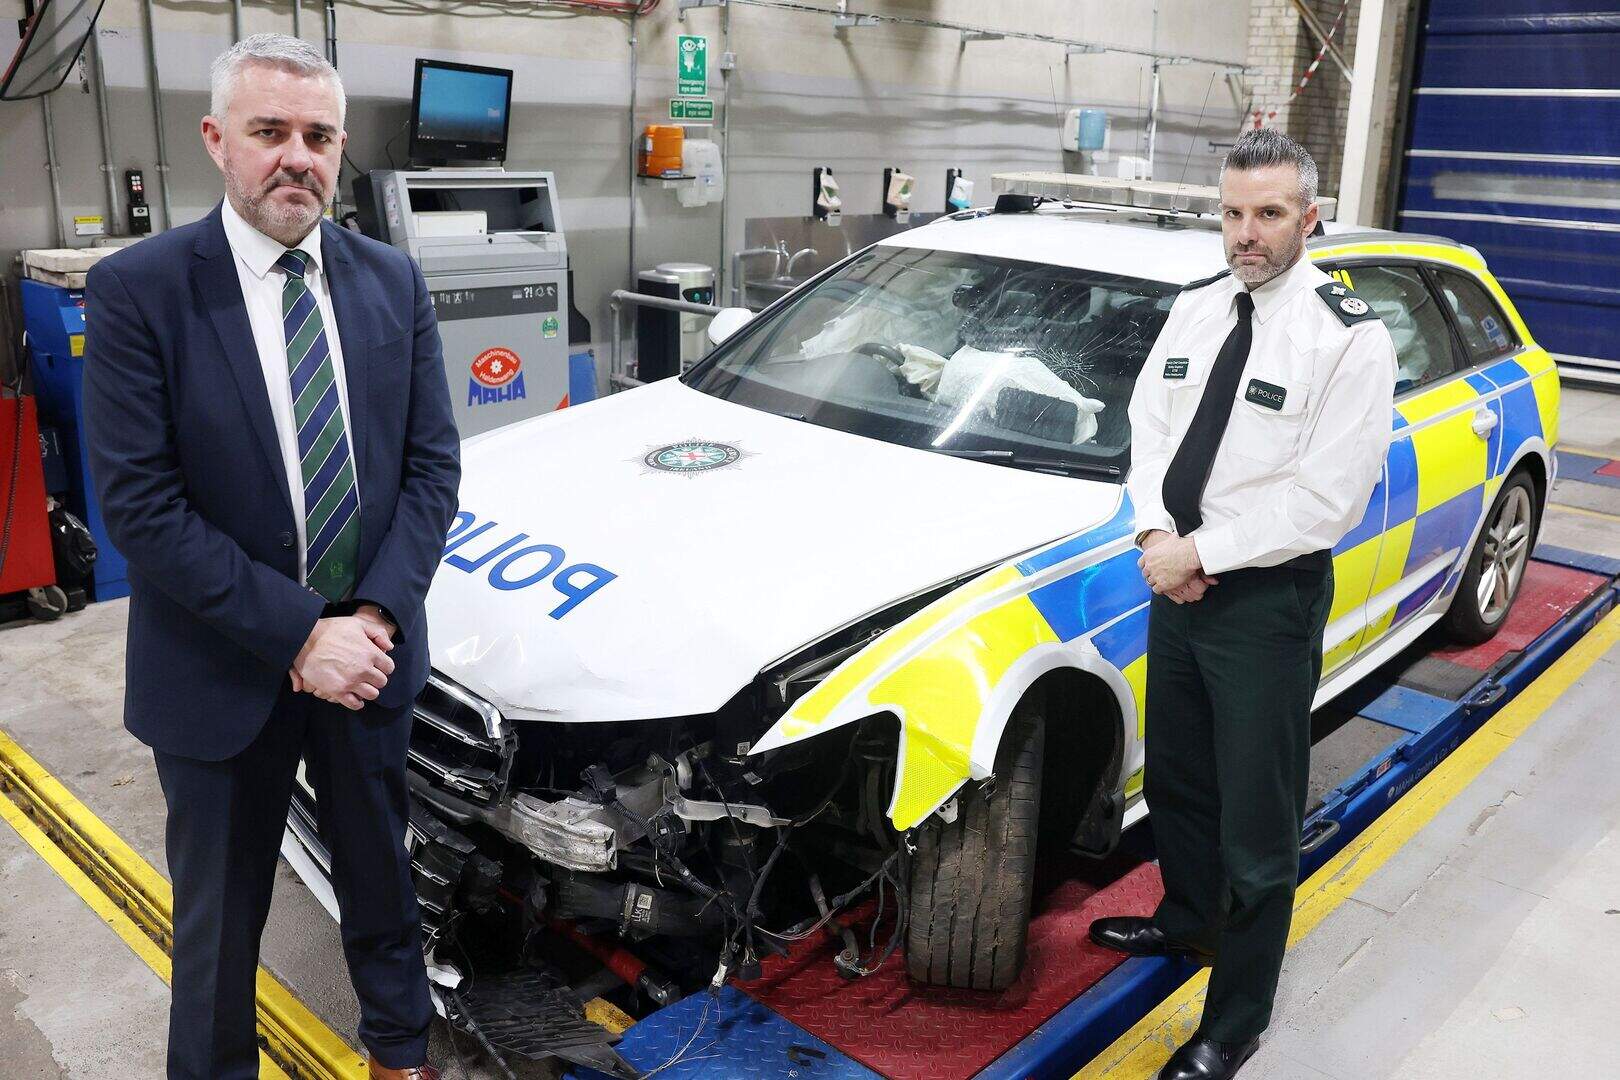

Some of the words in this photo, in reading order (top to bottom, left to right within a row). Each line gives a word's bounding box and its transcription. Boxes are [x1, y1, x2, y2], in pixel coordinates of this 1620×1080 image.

[686, 102, 712, 110] Emergency
[475, 350, 518, 368] Maschinenbau
[468, 371, 526, 406] MAHA
[1257, 389, 1283, 403] POLICE
